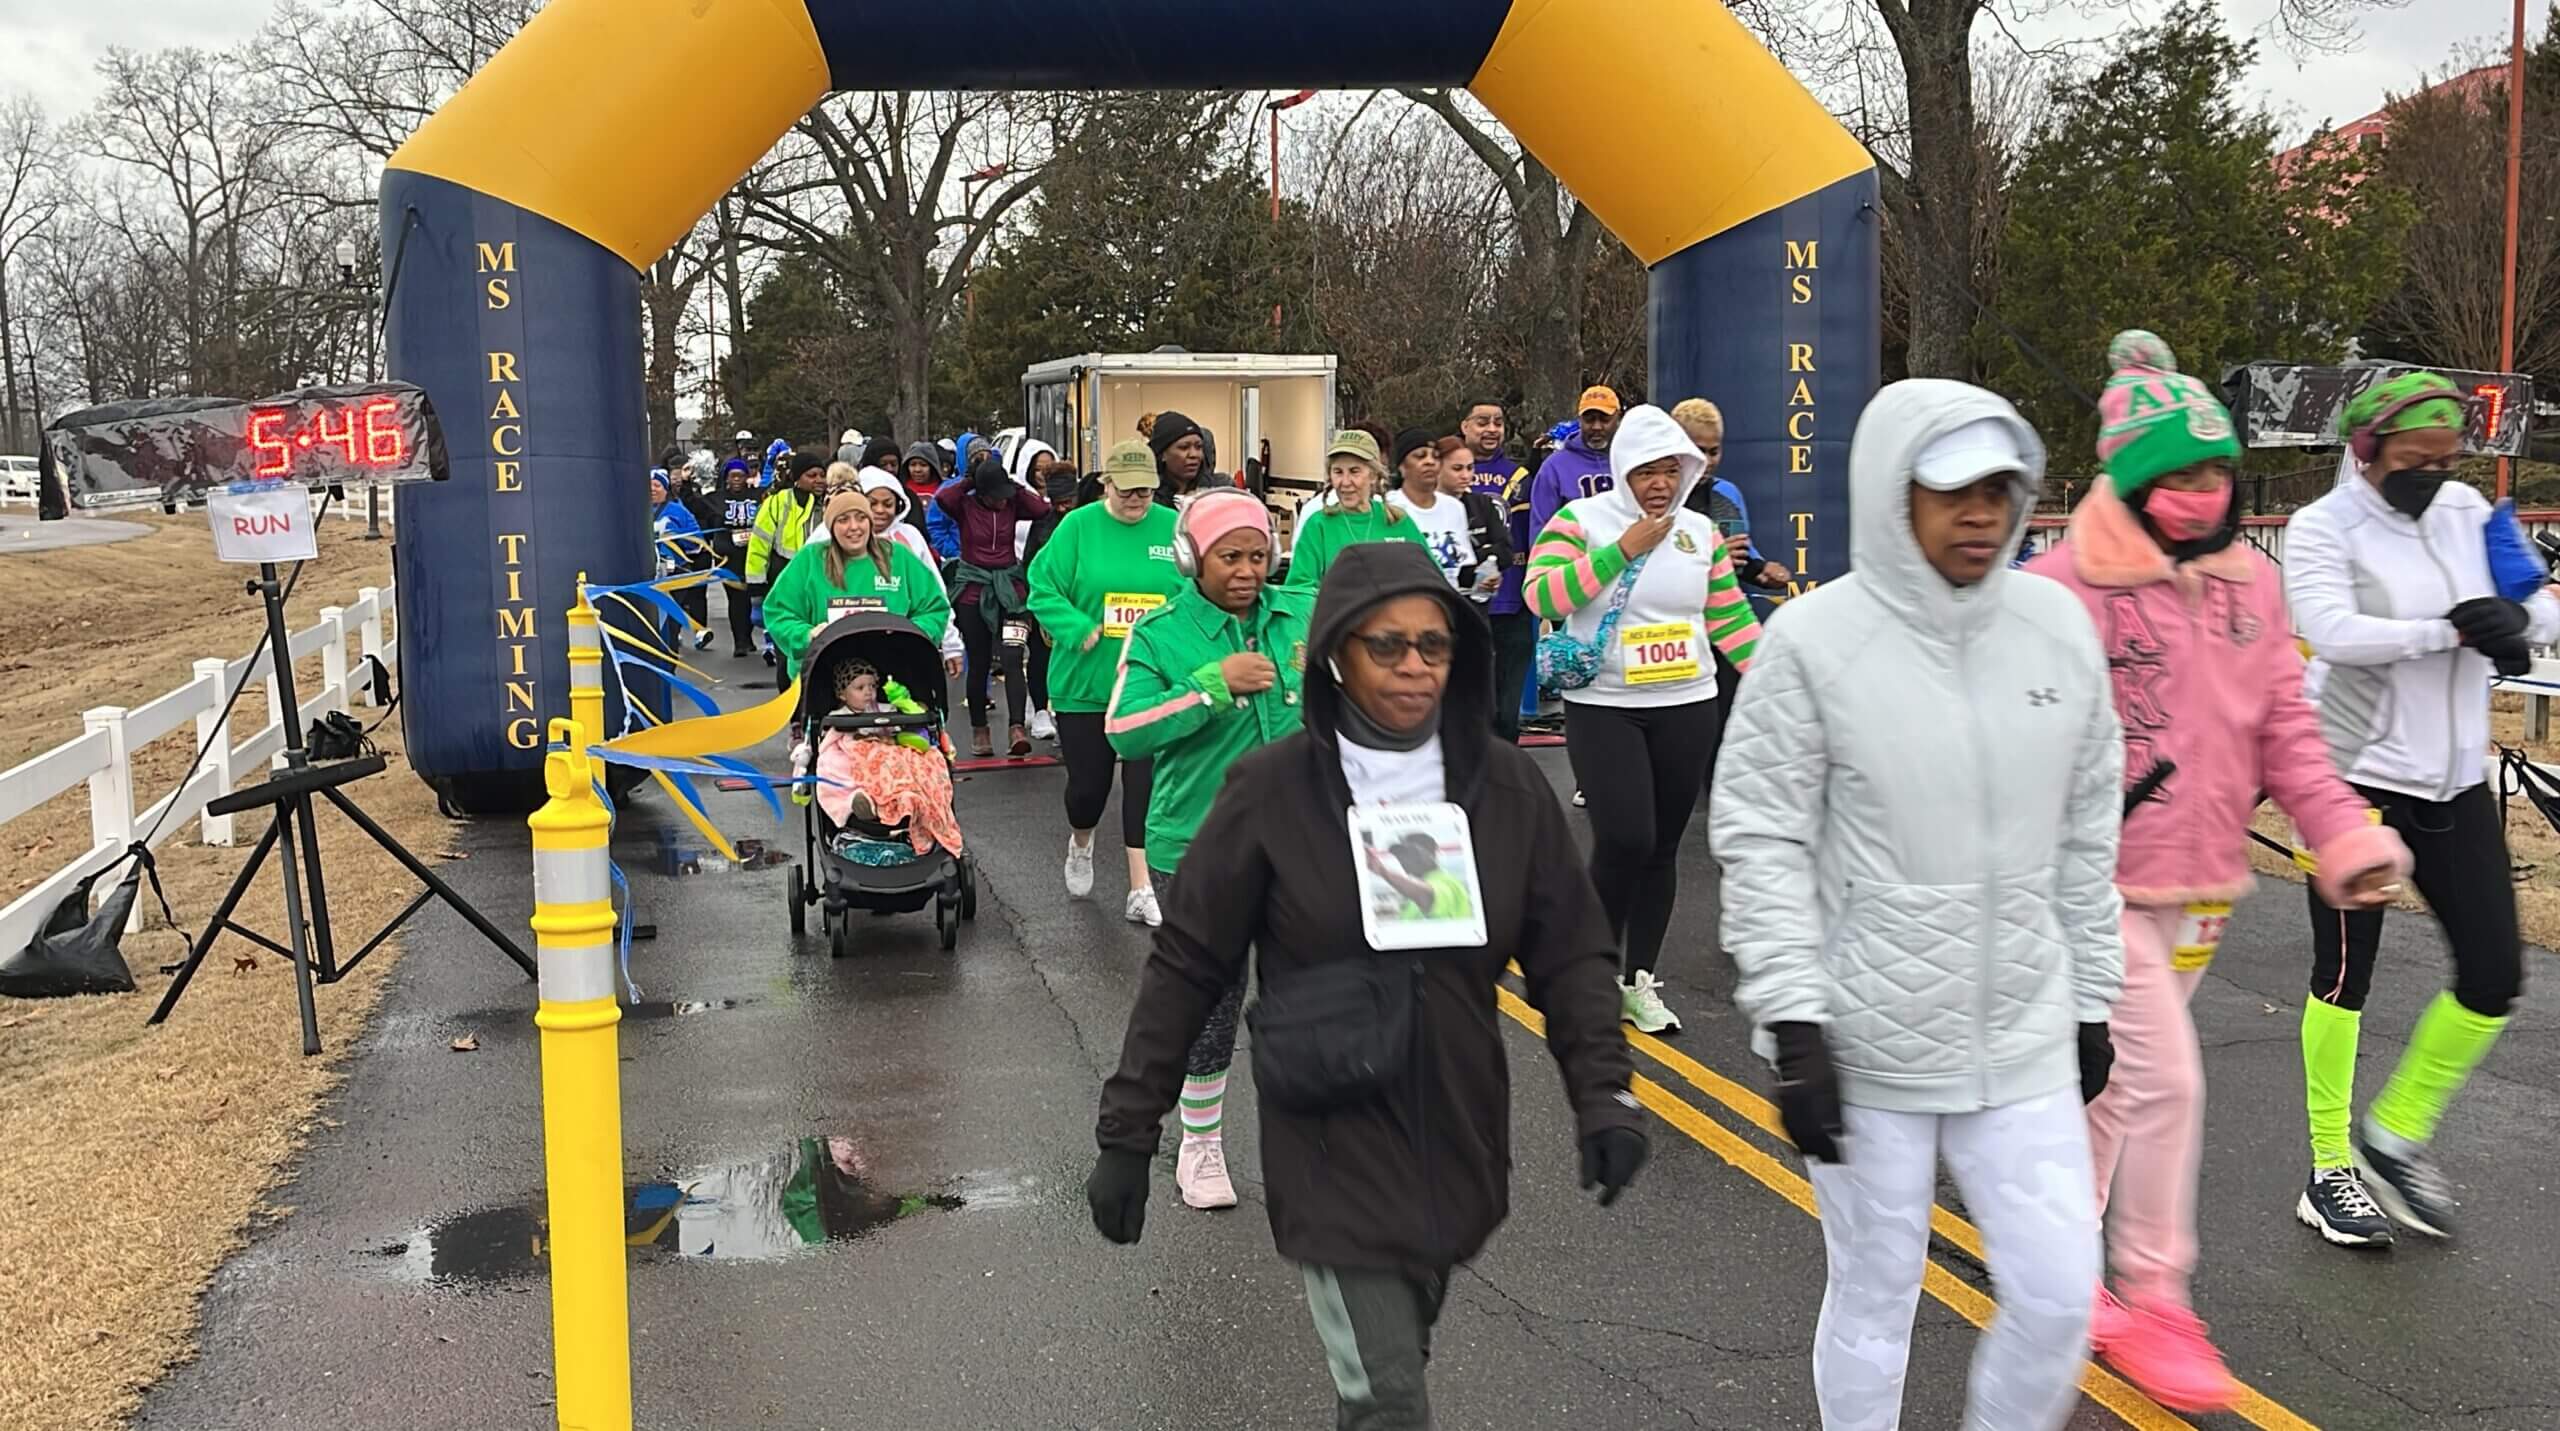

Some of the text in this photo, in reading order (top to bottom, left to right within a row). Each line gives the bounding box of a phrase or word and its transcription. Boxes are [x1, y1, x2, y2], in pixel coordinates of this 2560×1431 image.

[1784, 240, 1819, 304] MS
[1787, 343, 1816, 473] RACE
[476, 242, 541, 750] MS RACE TIMING
[233, 512, 291, 537] RUN
[1114, 607, 1155, 624] 102
[1635, 641, 1688, 665] 1004
